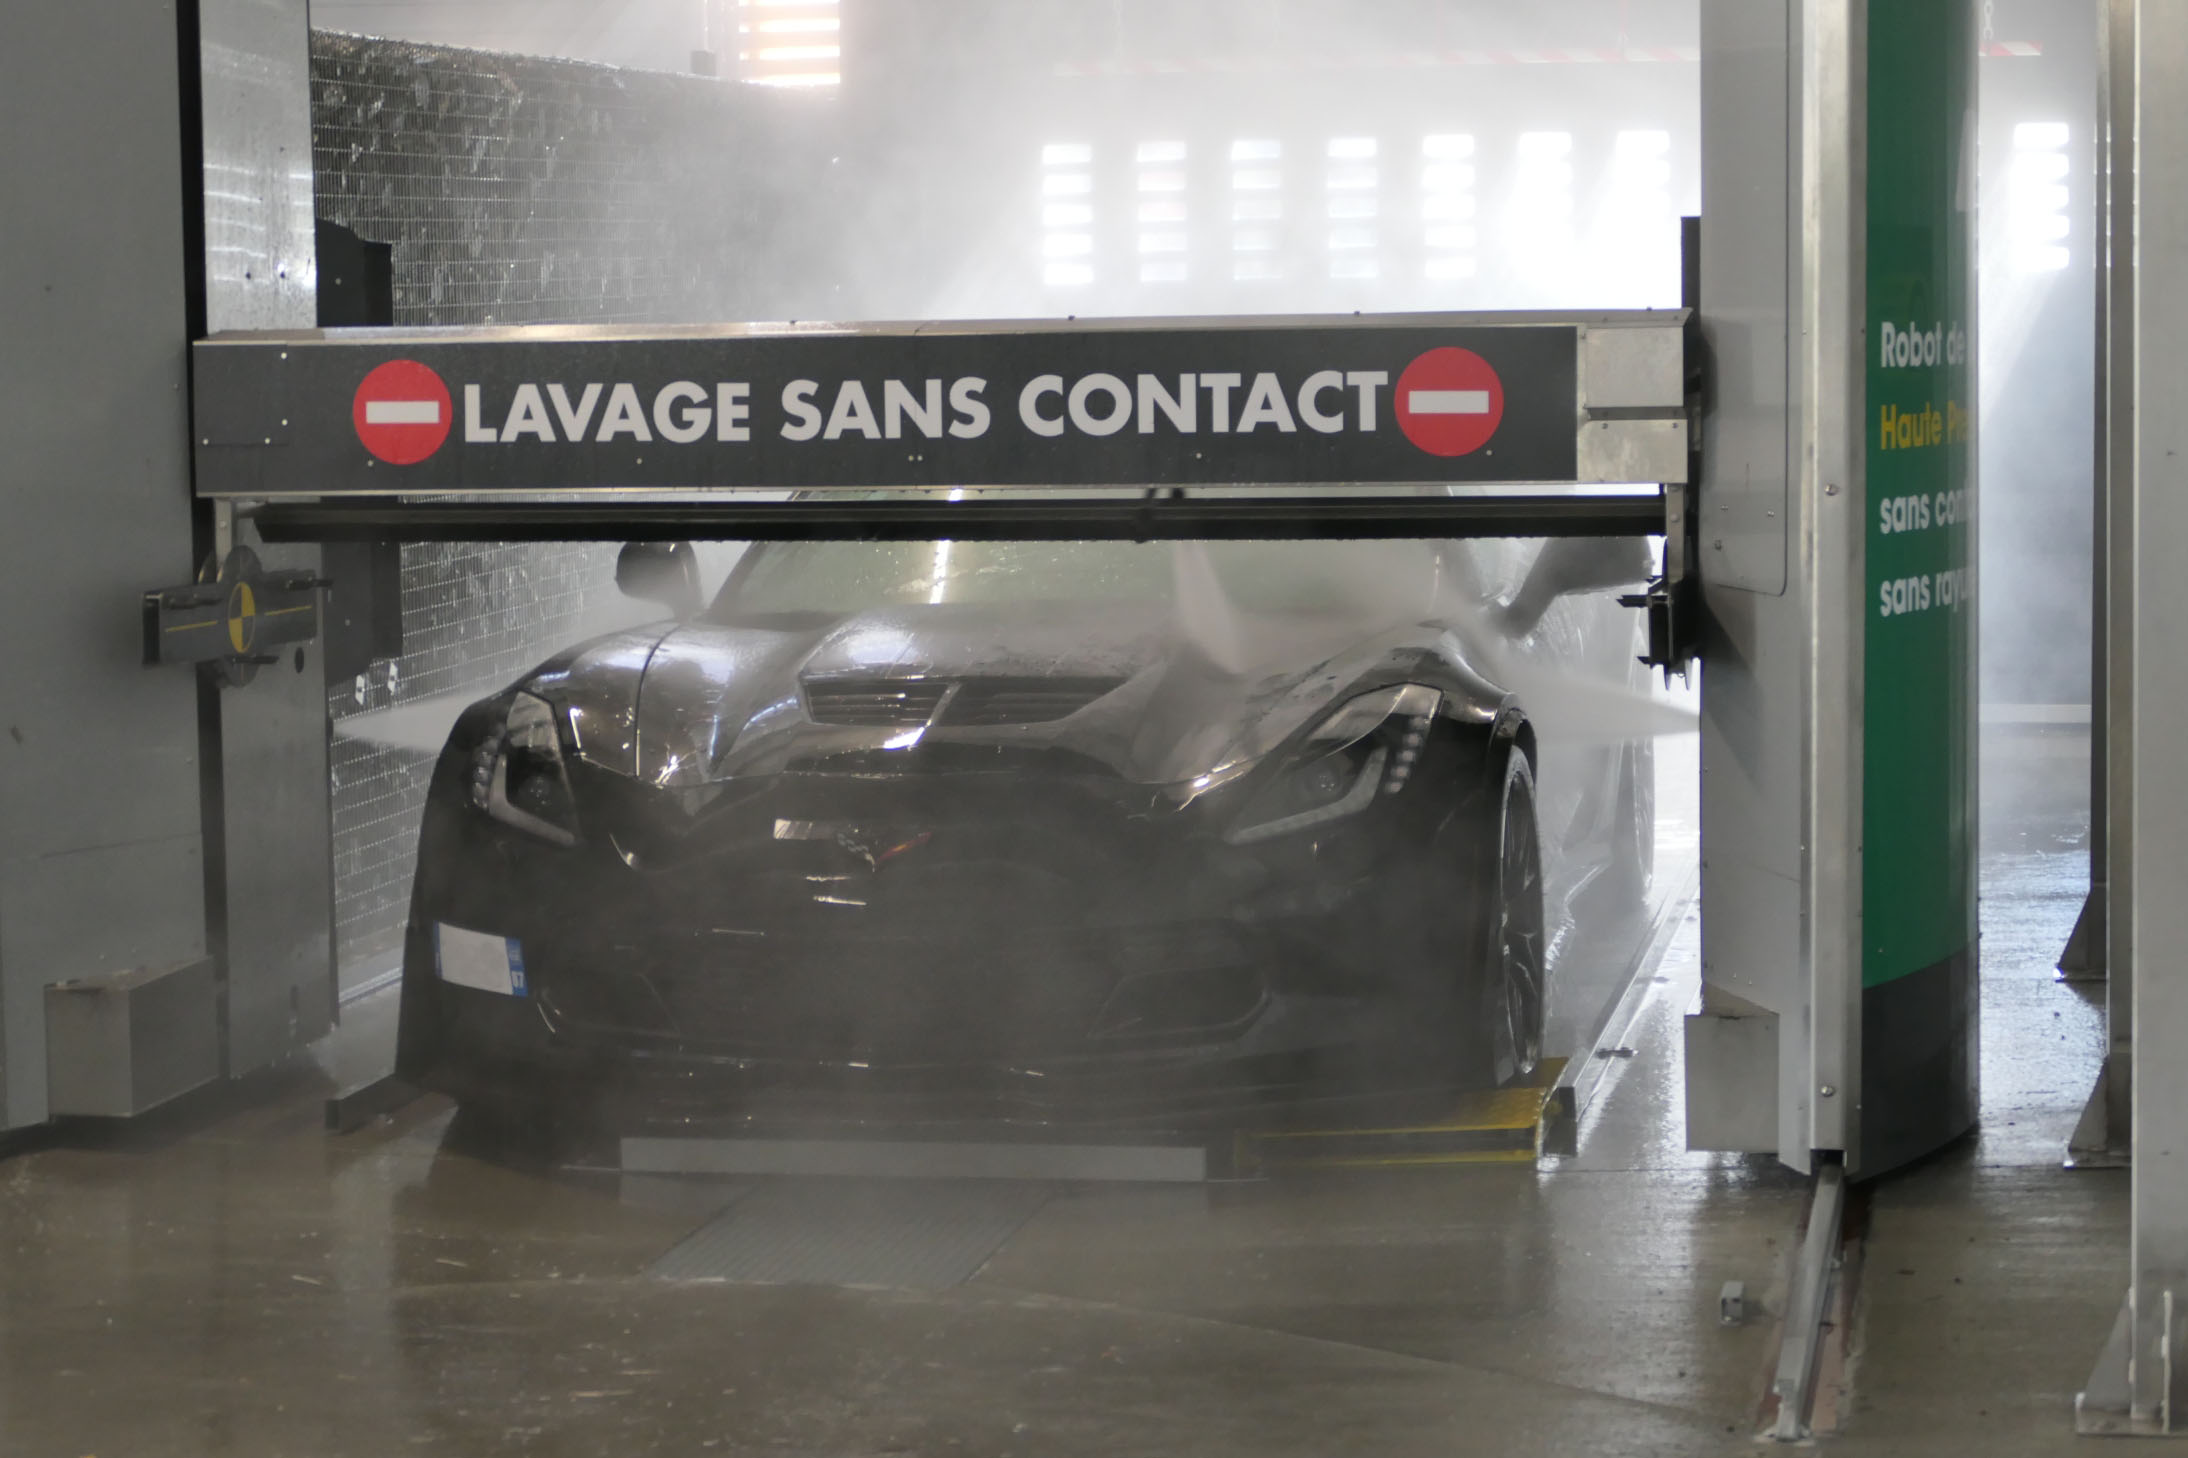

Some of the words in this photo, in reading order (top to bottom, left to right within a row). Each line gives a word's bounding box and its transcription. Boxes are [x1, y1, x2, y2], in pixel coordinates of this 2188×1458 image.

[1880, 321, 1943, 368] Robot
[1946, 320, 1966, 366] de
[465, 381, 750, 443] LAVAGE
[781, 377, 990, 441] SANS
[1019, 370, 1388, 436] CONTACT
[1880, 402, 1943, 450] Haute
[1880, 493, 1931, 534] sans
[1880, 574, 1931, 617] sans
